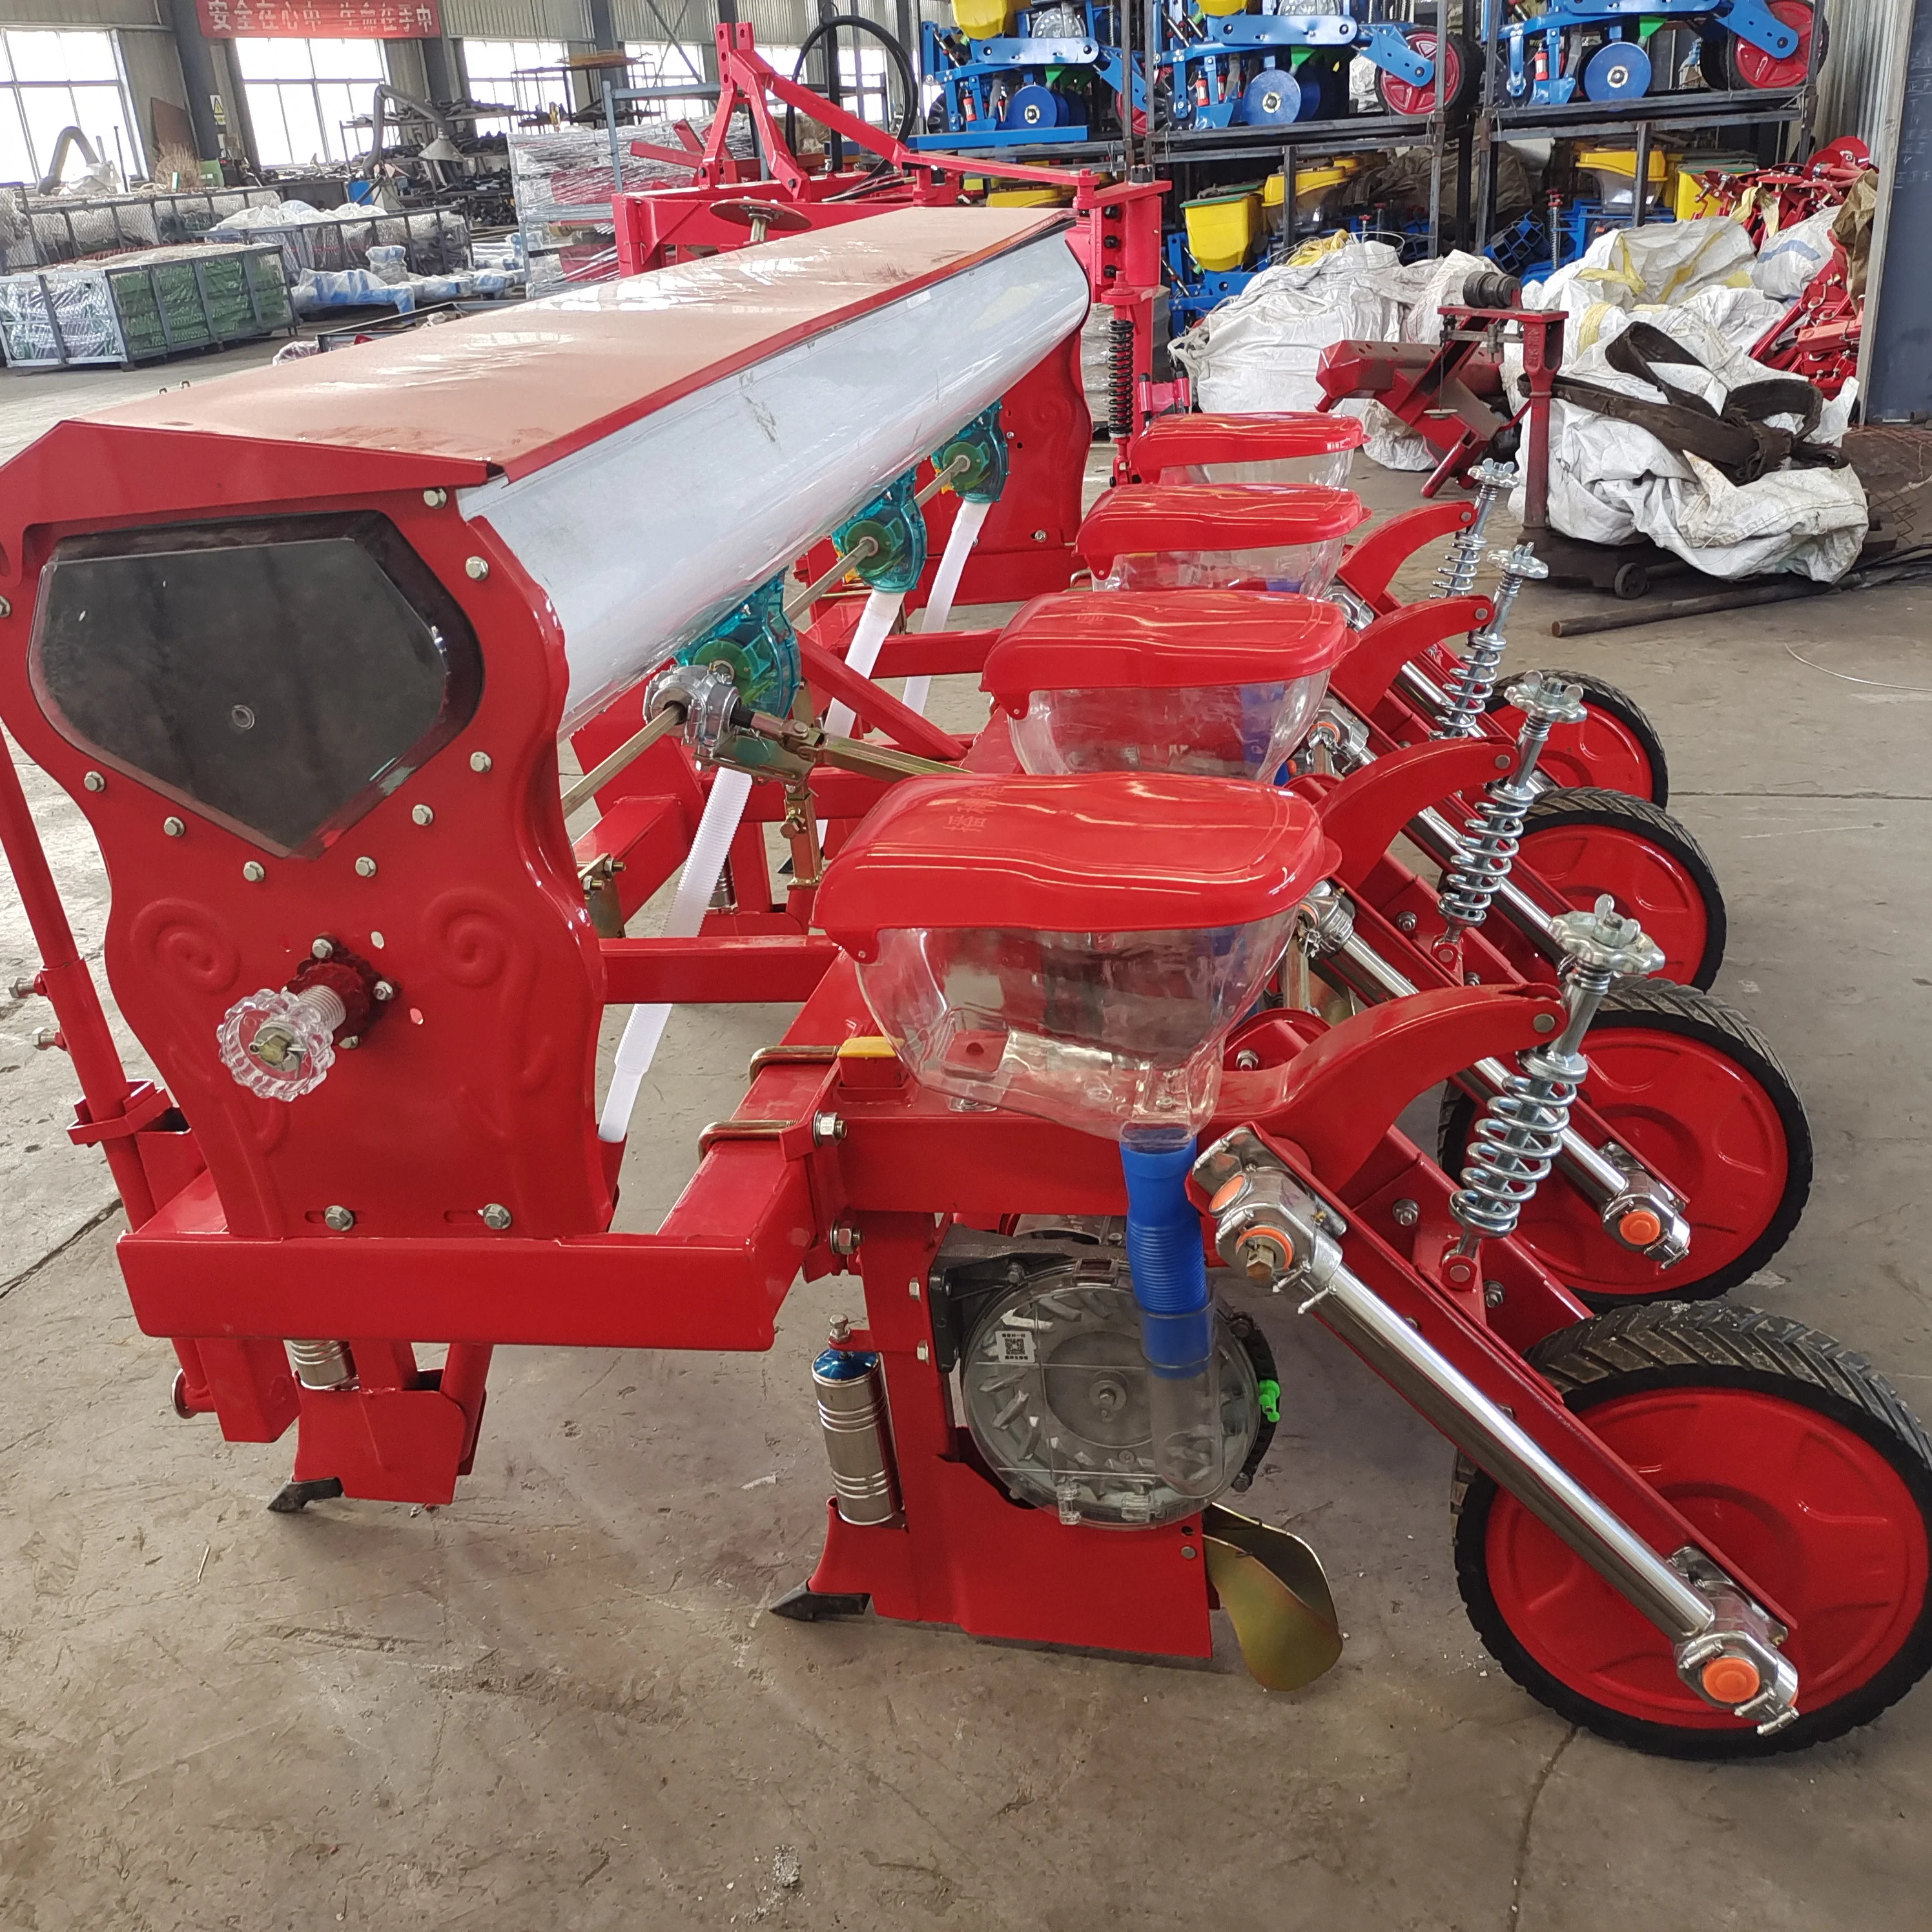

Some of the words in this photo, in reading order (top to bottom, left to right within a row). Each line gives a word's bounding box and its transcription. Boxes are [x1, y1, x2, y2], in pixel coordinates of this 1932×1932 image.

[207, 0, 322, 32] 安全在心中
[340, 2, 432, 32] 生命在手中
